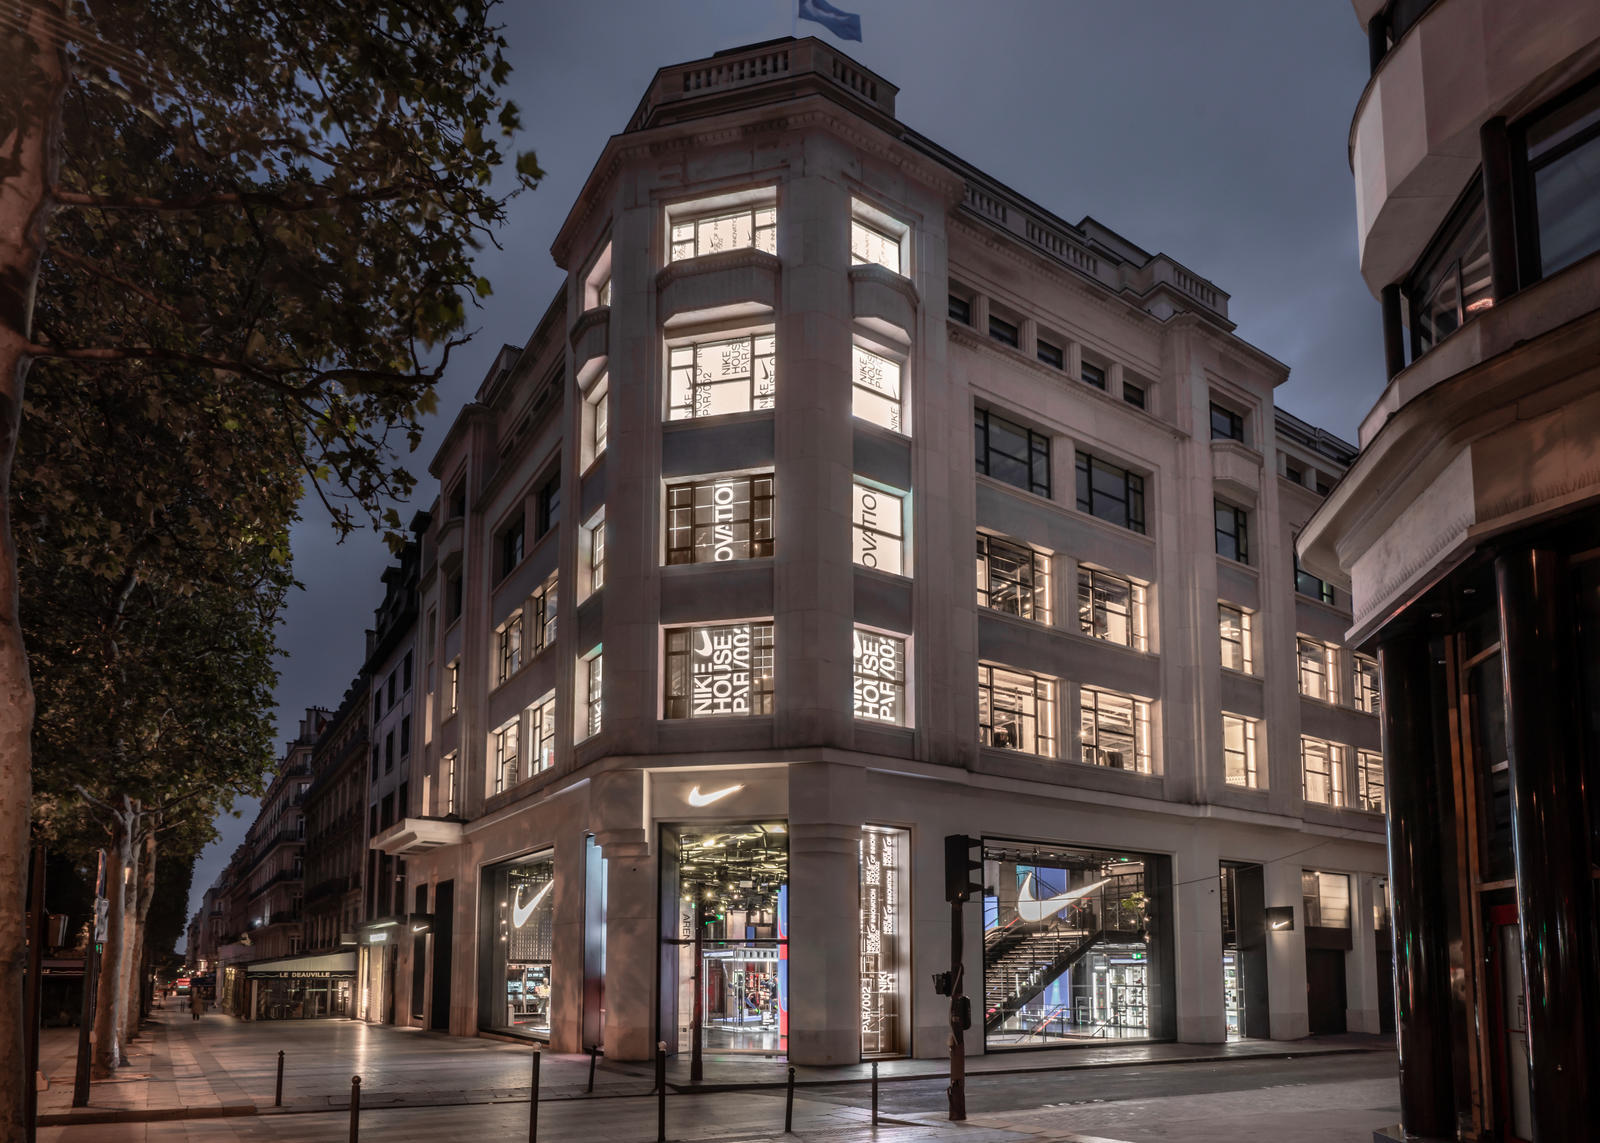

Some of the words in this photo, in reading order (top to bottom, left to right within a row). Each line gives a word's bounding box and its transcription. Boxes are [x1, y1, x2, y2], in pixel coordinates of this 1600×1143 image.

[722, 351, 731, 376] NIKE
[731, 339, 741, 375] HOUS
[860, 358, 868, 383] NIKE
[694, 662, 713, 716] NIKE
[712, 635, 732, 715] HOUSE
[862, 639, 880, 719] HOUSE
